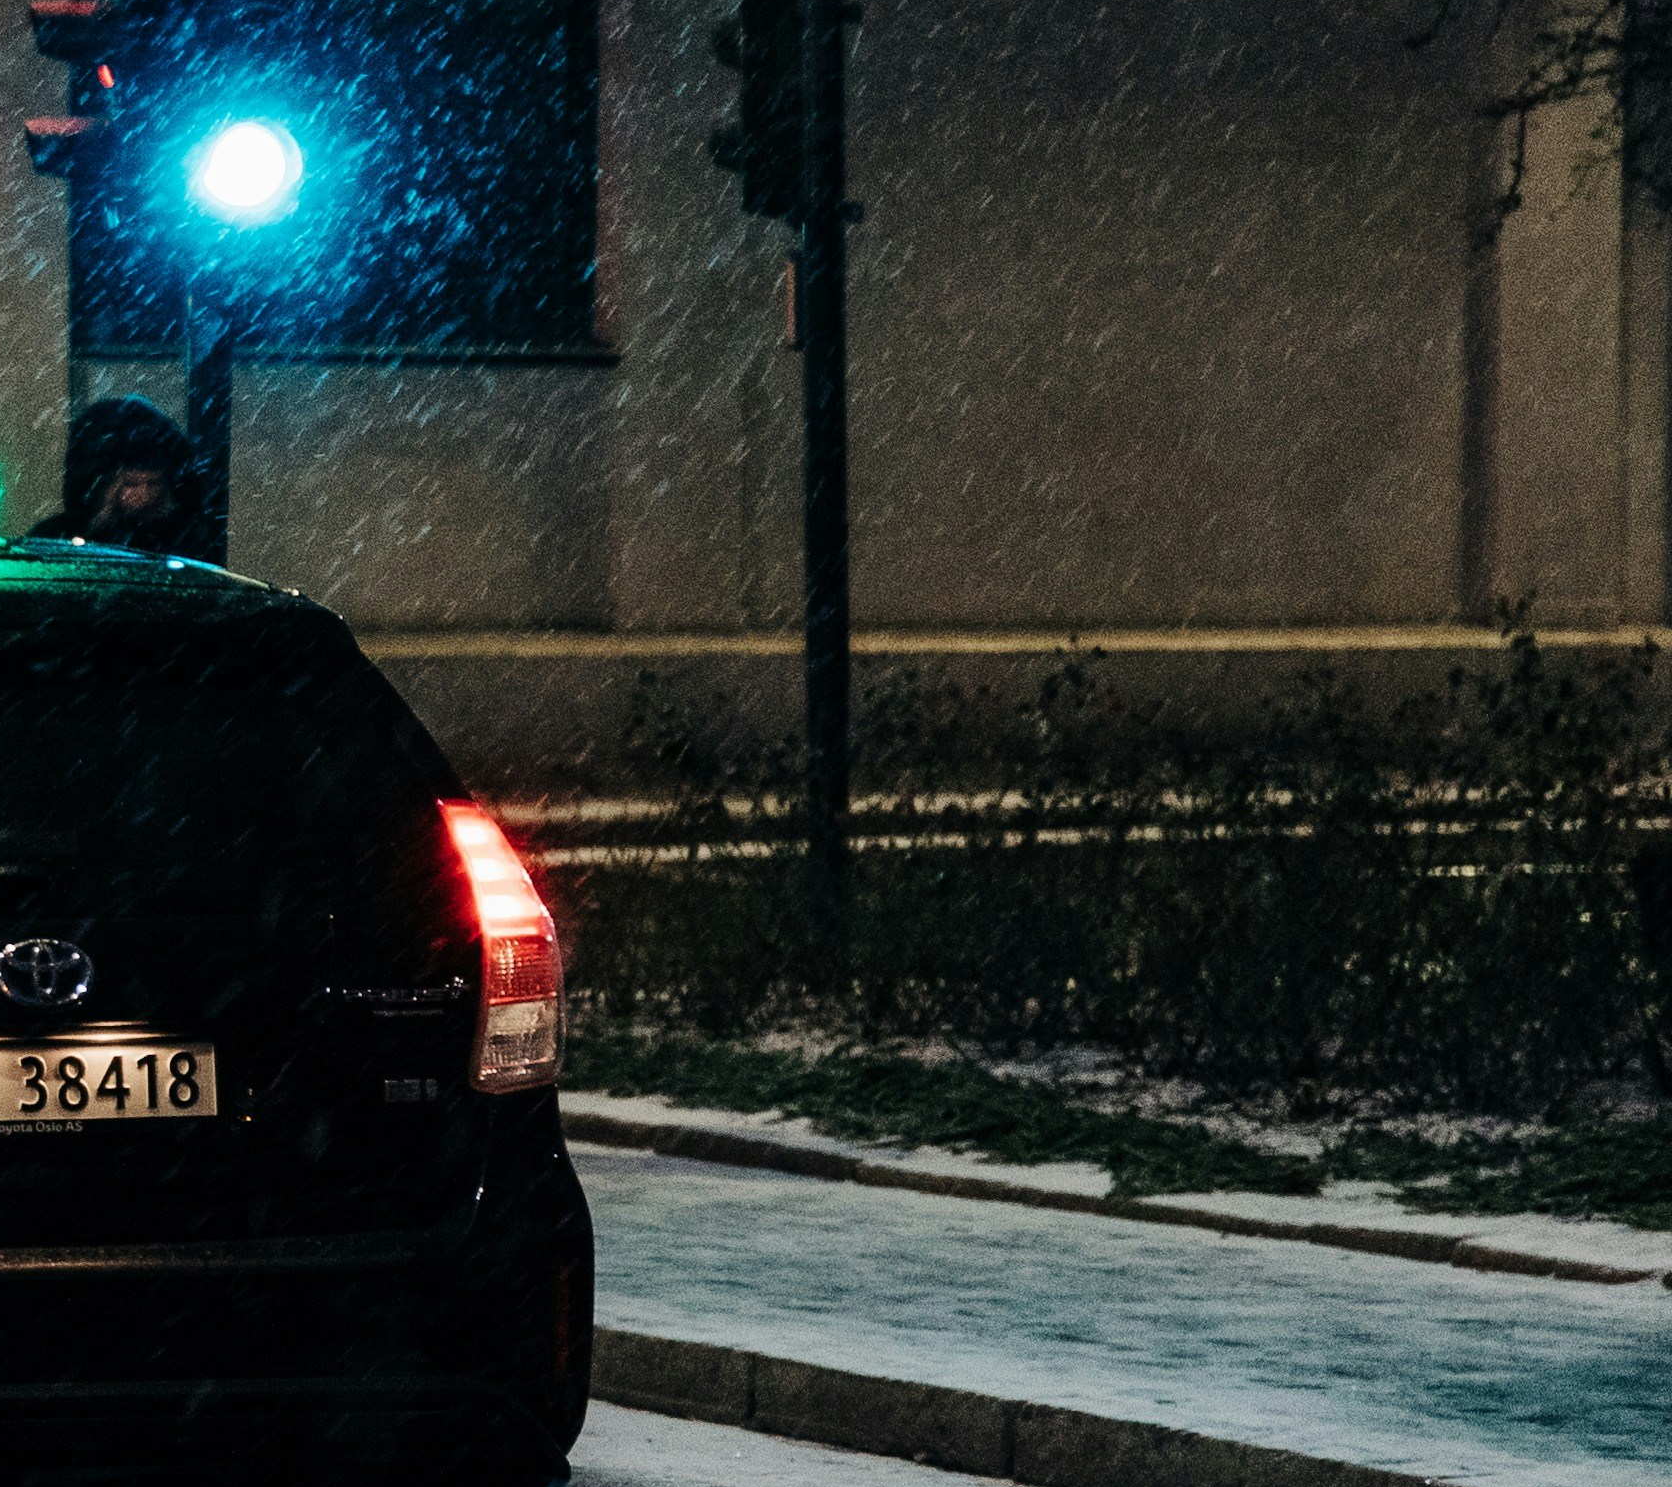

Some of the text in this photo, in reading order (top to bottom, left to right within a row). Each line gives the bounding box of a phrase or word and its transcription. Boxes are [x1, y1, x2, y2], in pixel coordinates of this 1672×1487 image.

[17, 1051, 201, 1113] 38418
[35, 1120, 63, 1133] Oslo
[65, 1120, 84, 1133] AS
